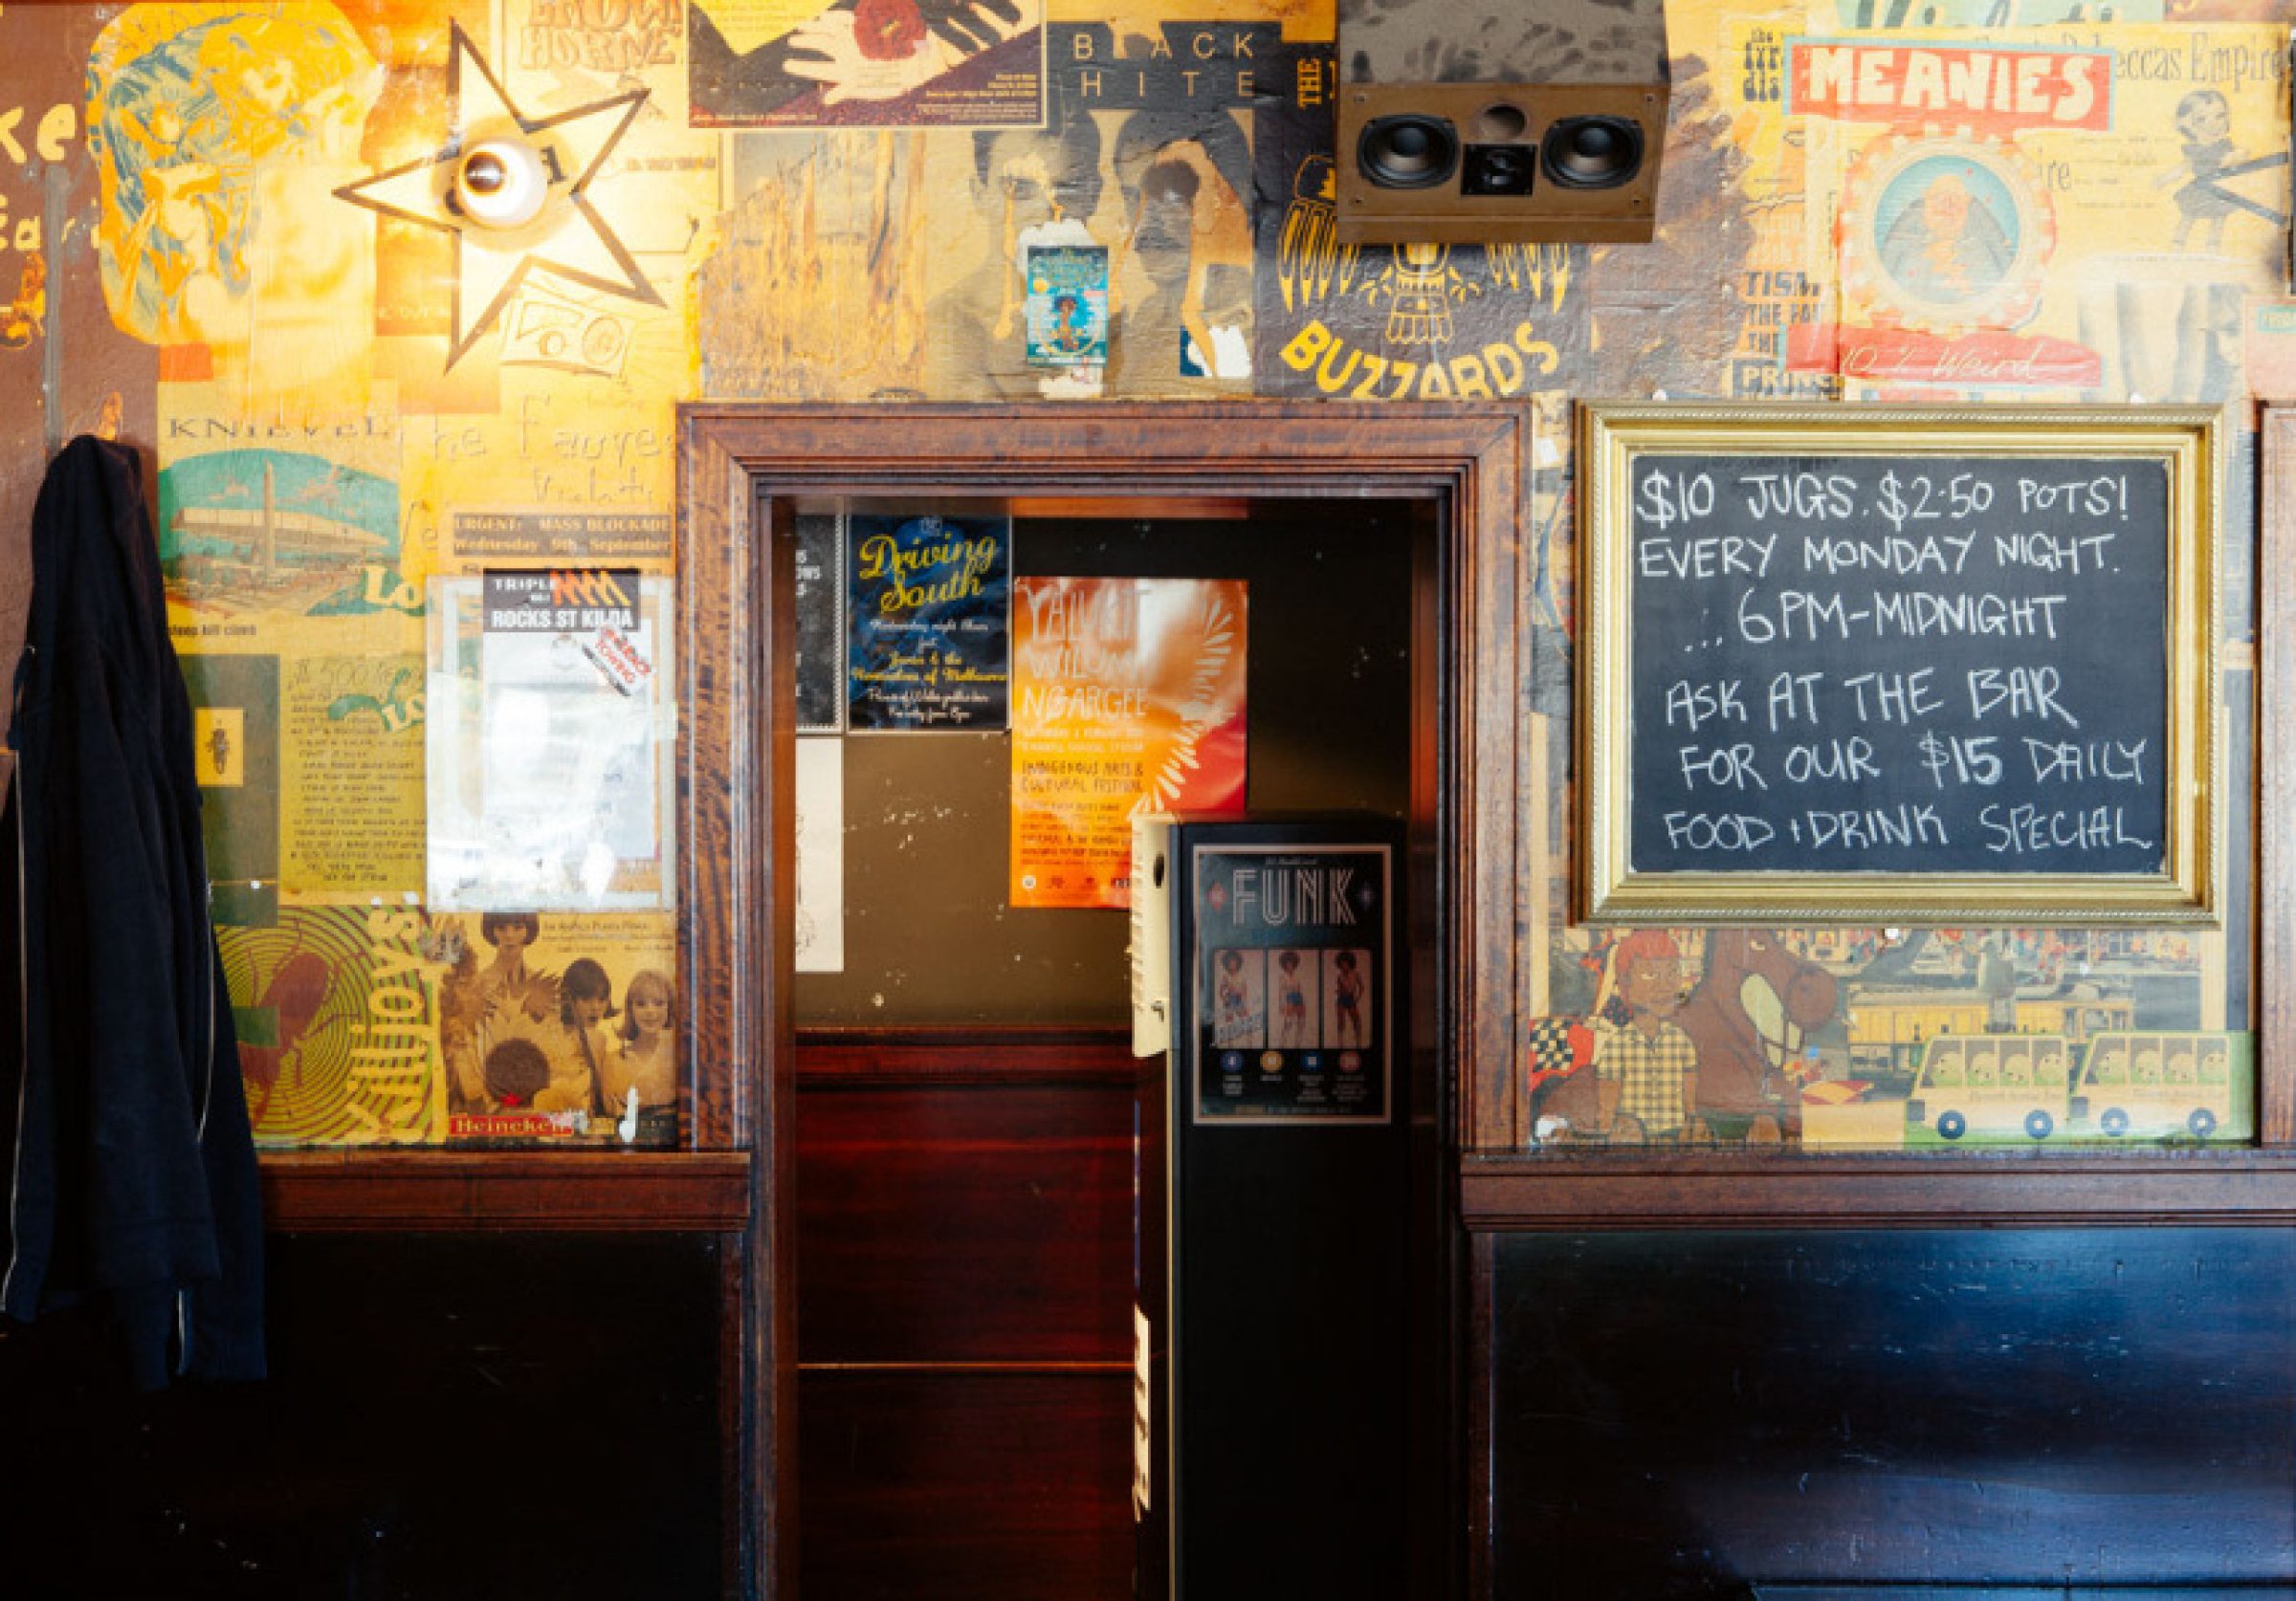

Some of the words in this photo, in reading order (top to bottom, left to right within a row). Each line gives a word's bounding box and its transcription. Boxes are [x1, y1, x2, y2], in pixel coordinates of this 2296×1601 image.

[1073, 32, 1254, 59] BACK
[1808, 46, 2095, 121] MEANIES
[1279, 319, 1560, 399] BUZZARDS
[539, 517, 580, 531] MASS
[1636, 469, 1715, 530] $10
[2018, 474, 2130, 521] POTS!
[858, 530, 998, 580] Driving
[1639, 533, 1778, 580] EVERY
[1804, 529, 1976, 576] MONDAY
[491, 610, 551, 628] ROCKS
[554, 610, 578, 628] ST
[880, 570, 982, 618] South
[1666, 680, 1748, 733] ASK
[1769, 670, 1824, 734] AT
[1843, 667, 1944, 725] THE
[1968, 666, 2080, 730] BAR
[1679, 741, 1768, 791] FOR
[1785, 735, 1881, 783] OUR
[1918, 729, 2004, 789] $15
[2020, 737, 2148, 786] DAILY
[1663, 810, 1776, 850] FOOD
[1804, 804, 1949, 849] DRINK
[1979, 803, 2154, 853] SPECIAL
[1232, 868, 1357, 925] FUNK
